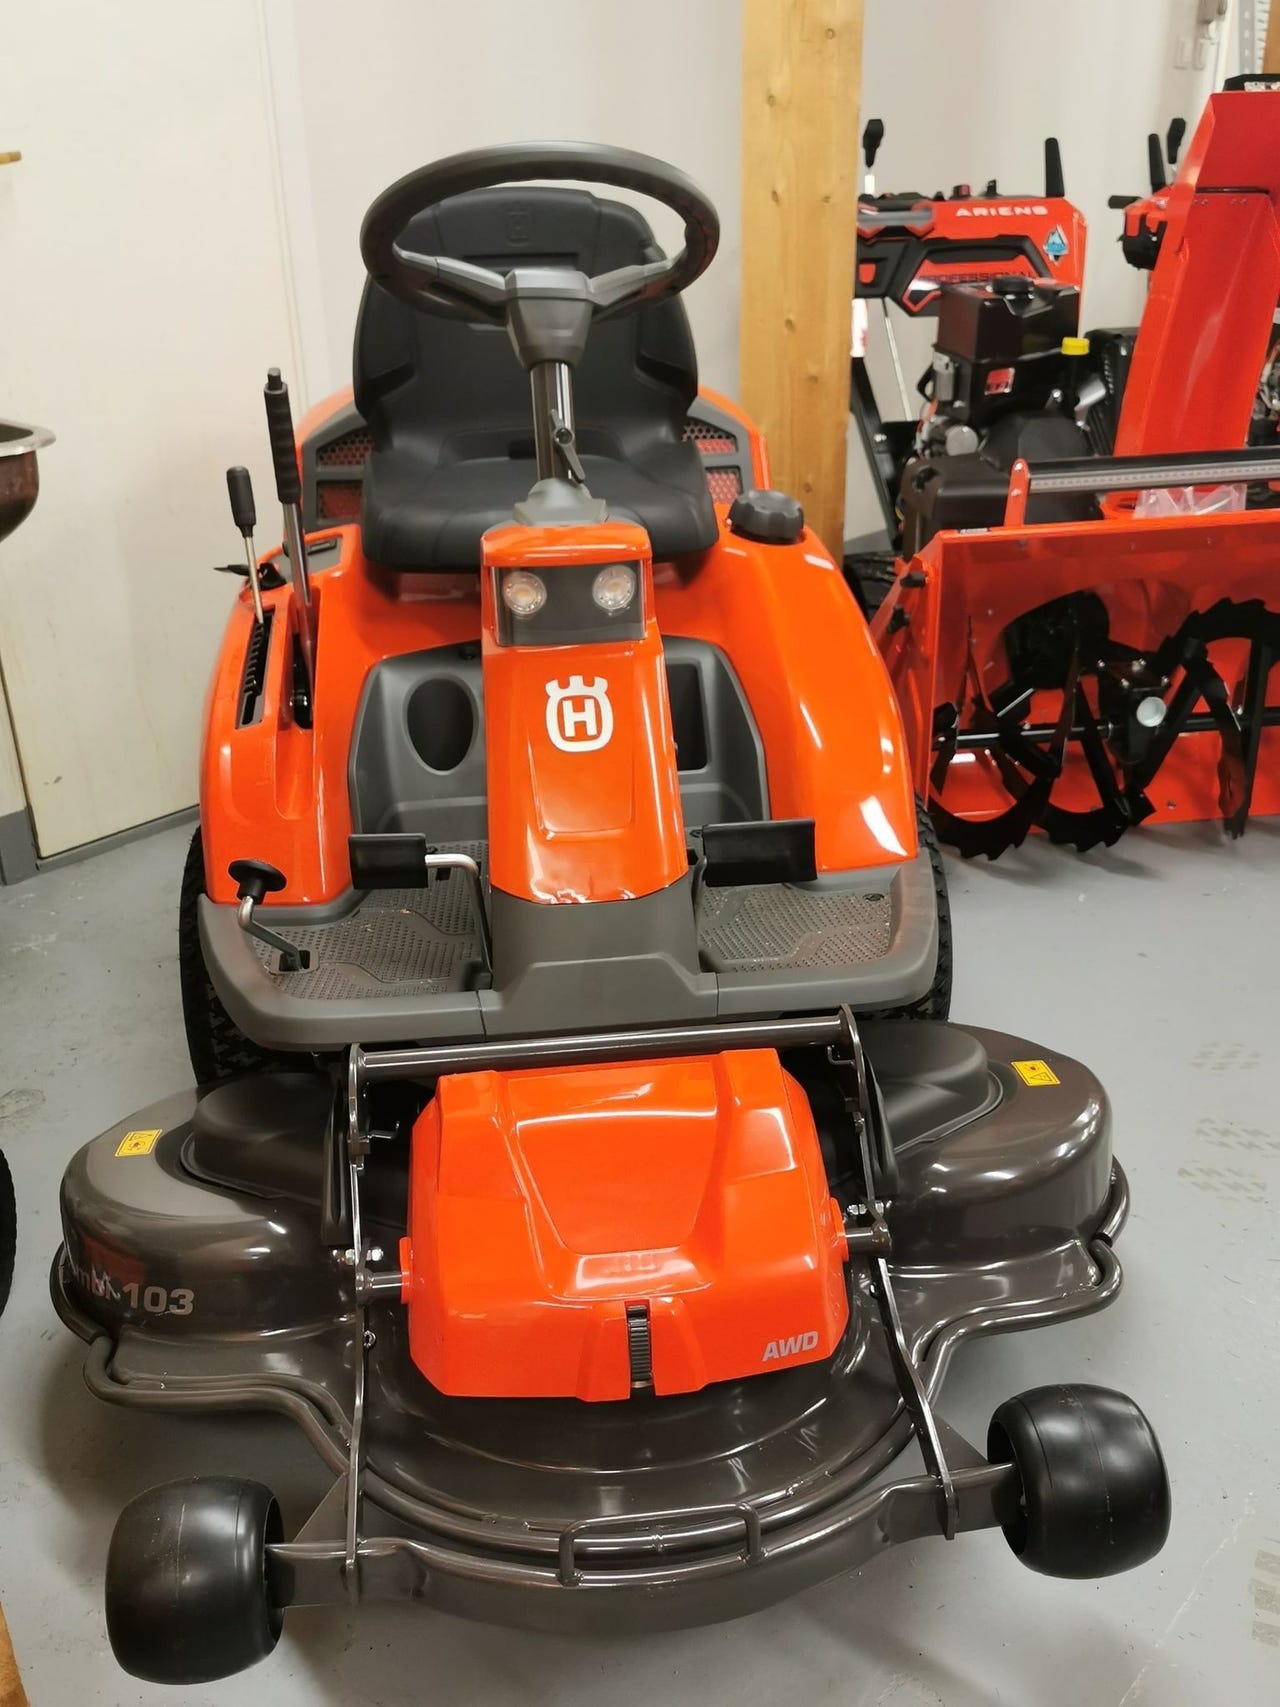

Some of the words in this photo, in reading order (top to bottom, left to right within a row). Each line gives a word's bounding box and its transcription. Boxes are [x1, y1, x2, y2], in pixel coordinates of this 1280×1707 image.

[955, 205, 1049, 217] ARIENS
[562, 698, 598, 737] H
[122, 1282, 195, 1316] 103
[761, 1330, 819, 1362] AWD
